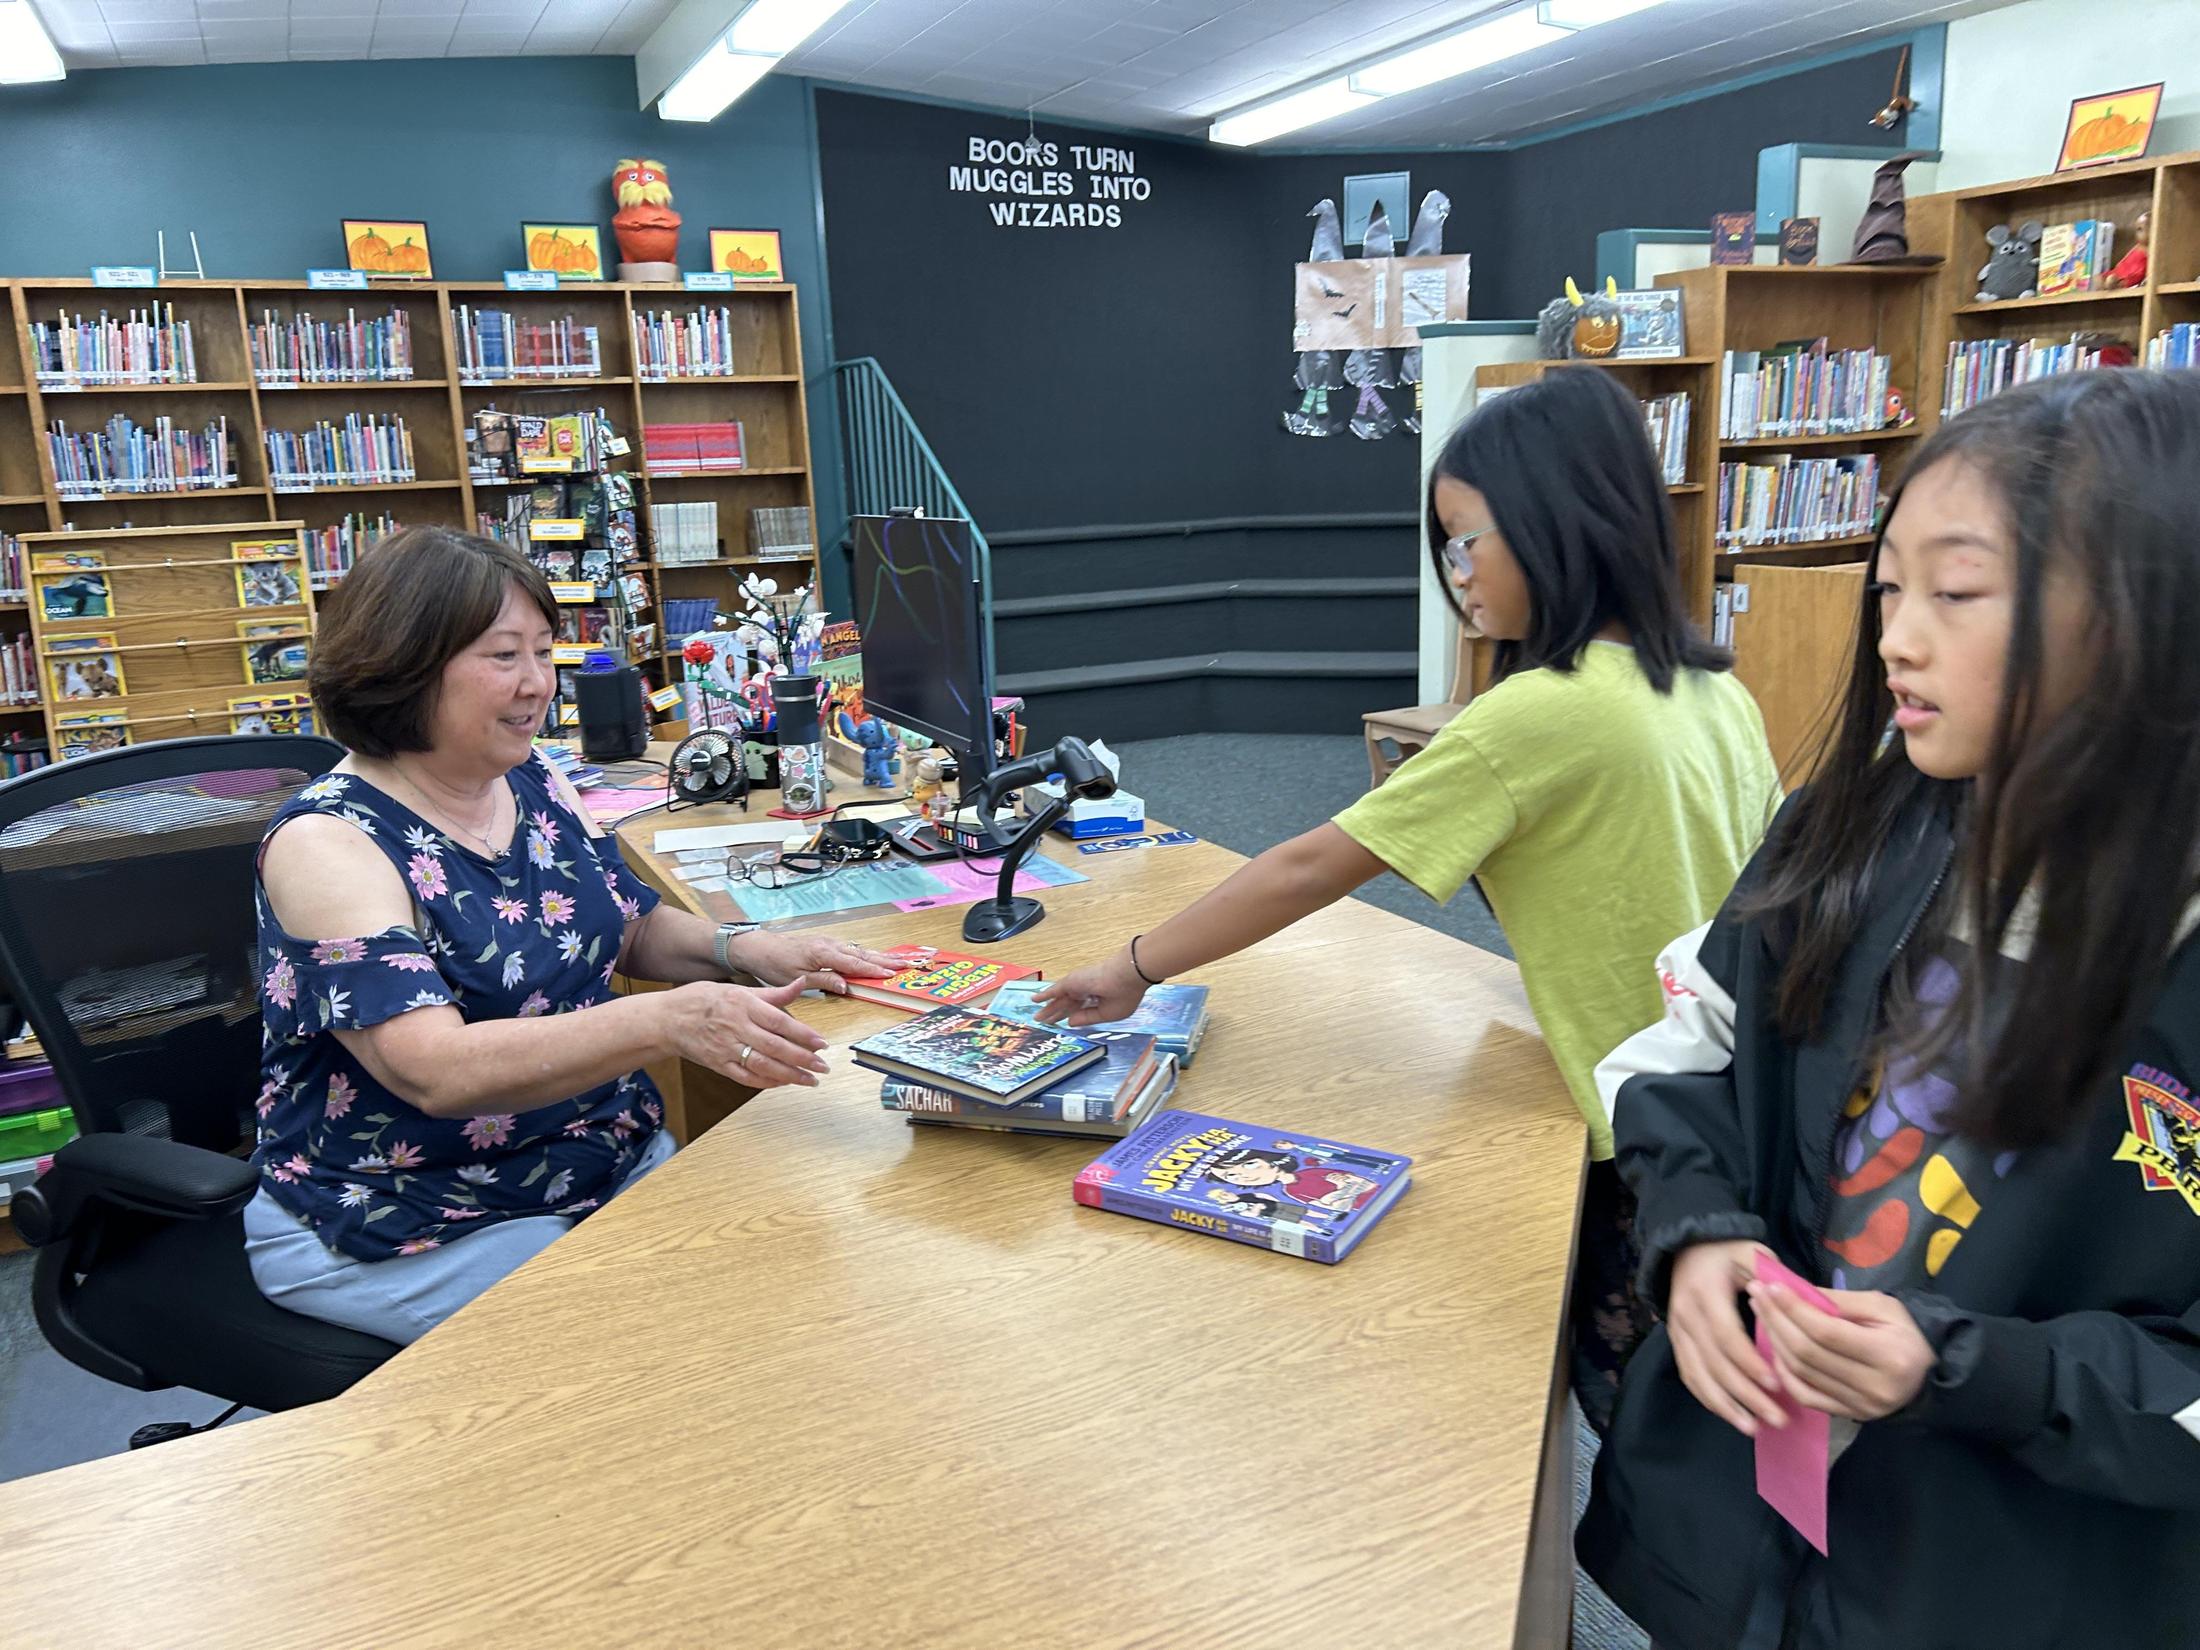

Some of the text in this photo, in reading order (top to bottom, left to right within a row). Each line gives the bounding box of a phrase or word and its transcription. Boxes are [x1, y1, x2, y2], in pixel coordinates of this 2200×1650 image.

[969, 136, 1135, 174] BOOKS TURN
[949, 167, 1151, 201] MUGGLES INTO
[989, 202, 1122, 228] WIZARDS
[45, 606, 73, 614] OCEAN
[831, 630, 861, 645] ANGEL
[896, 1083, 953, 1113] SACHAR
[1142, 1137, 1214, 1194] JACKY
[1177, 1179, 1196, 1192] MY
[1188, 1163, 1207, 1179] LIFE
[1205, 1154, 1219, 1164] IS
[1223, 1135, 1253, 1150] JOKE
[1170, 1208, 1215, 1230] JACKY
